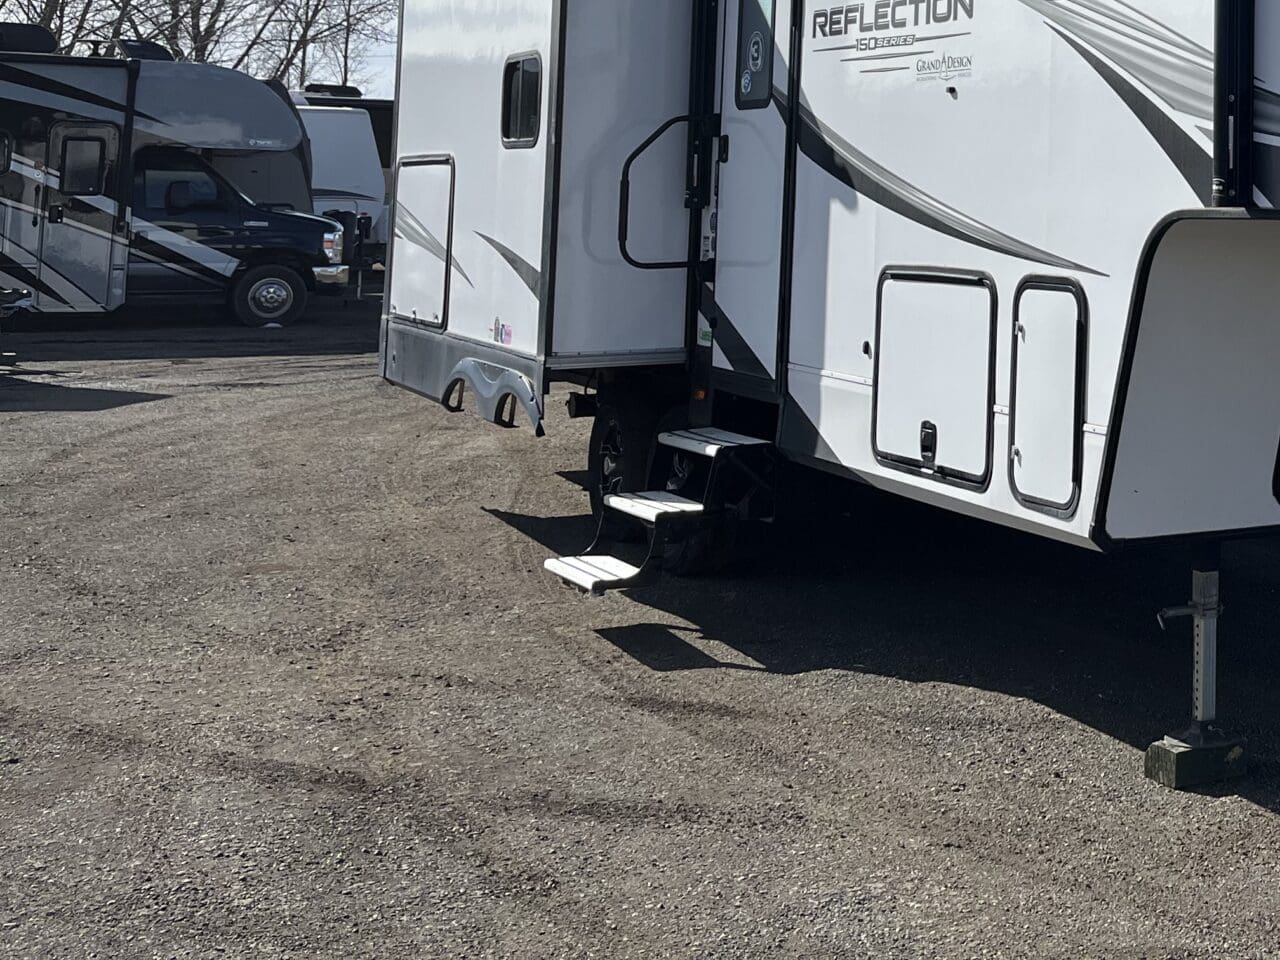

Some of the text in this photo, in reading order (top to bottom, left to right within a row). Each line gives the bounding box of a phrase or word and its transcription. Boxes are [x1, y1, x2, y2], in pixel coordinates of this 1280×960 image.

[876, 35, 914, 47] SERIES
[916, 55, 972, 72] GRAND DESIGN
